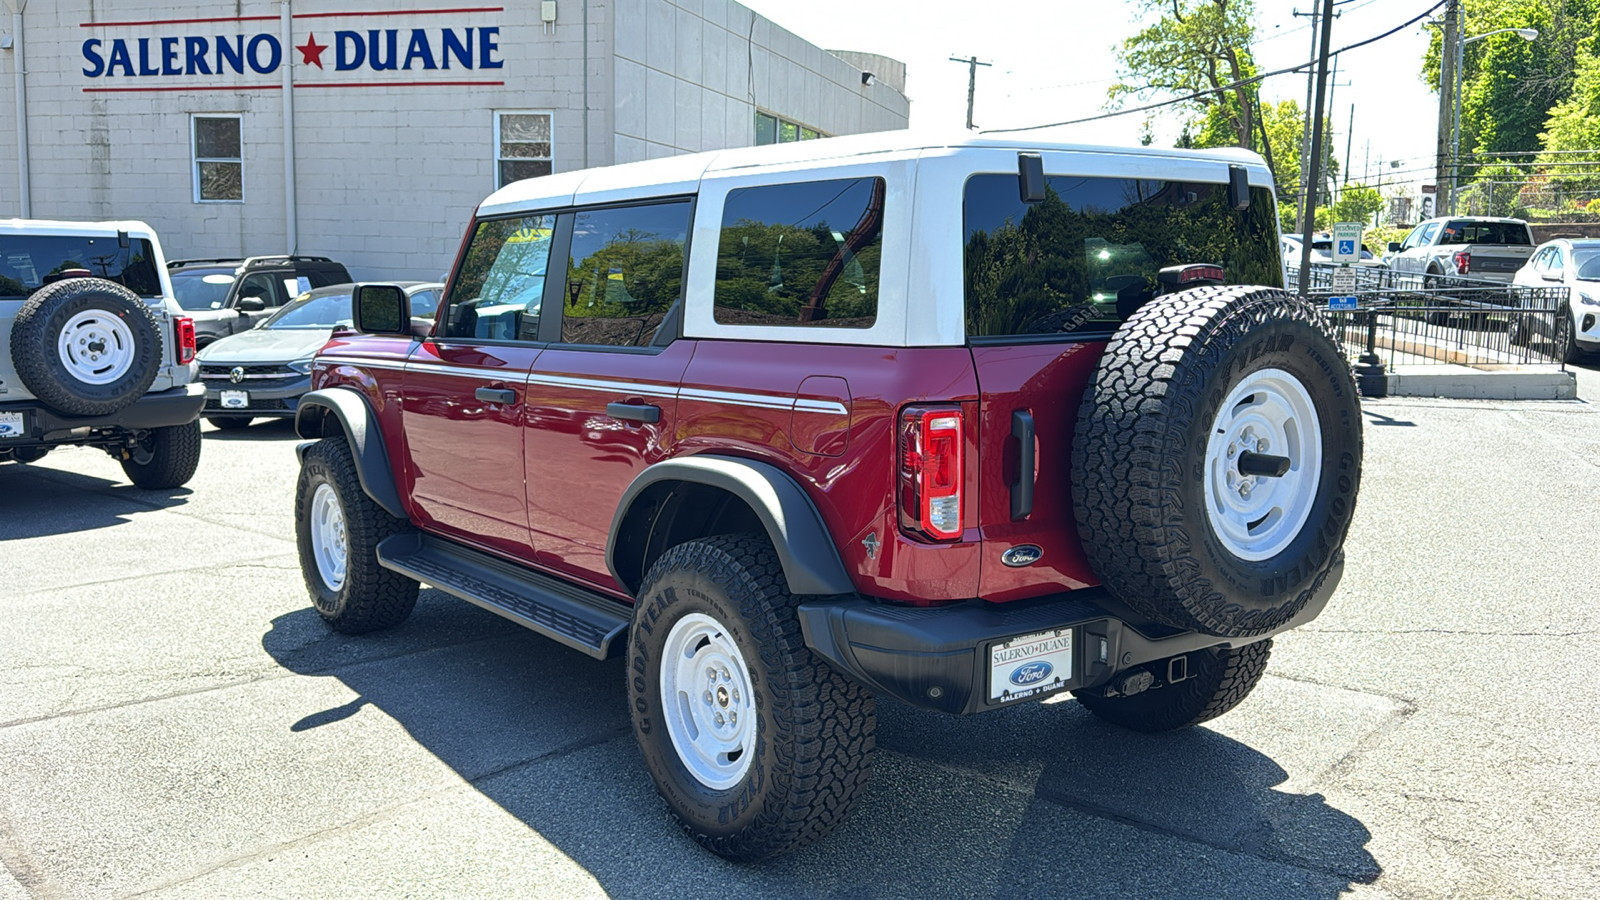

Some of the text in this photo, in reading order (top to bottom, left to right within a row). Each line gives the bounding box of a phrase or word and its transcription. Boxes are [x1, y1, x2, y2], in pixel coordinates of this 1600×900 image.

[82, 26, 504, 78] SALERNO DUANE
[1306, 346, 1343, 398] TERRITORY
[1192, 333, 1295, 482] GOODYEAR
[1260, 452, 1355, 597] GOODYEAR
[1012, 550, 1035, 563] Ford
[686, 588, 729, 620] TERRITORY
[632, 586, 679, 735] GOODYEAR
[993, 637, 1070, 664] SALERNO DUANE
[1000, 681, 1065, 703] SALERNO DUANE
[1018, 665, 1046, 683] Ford
